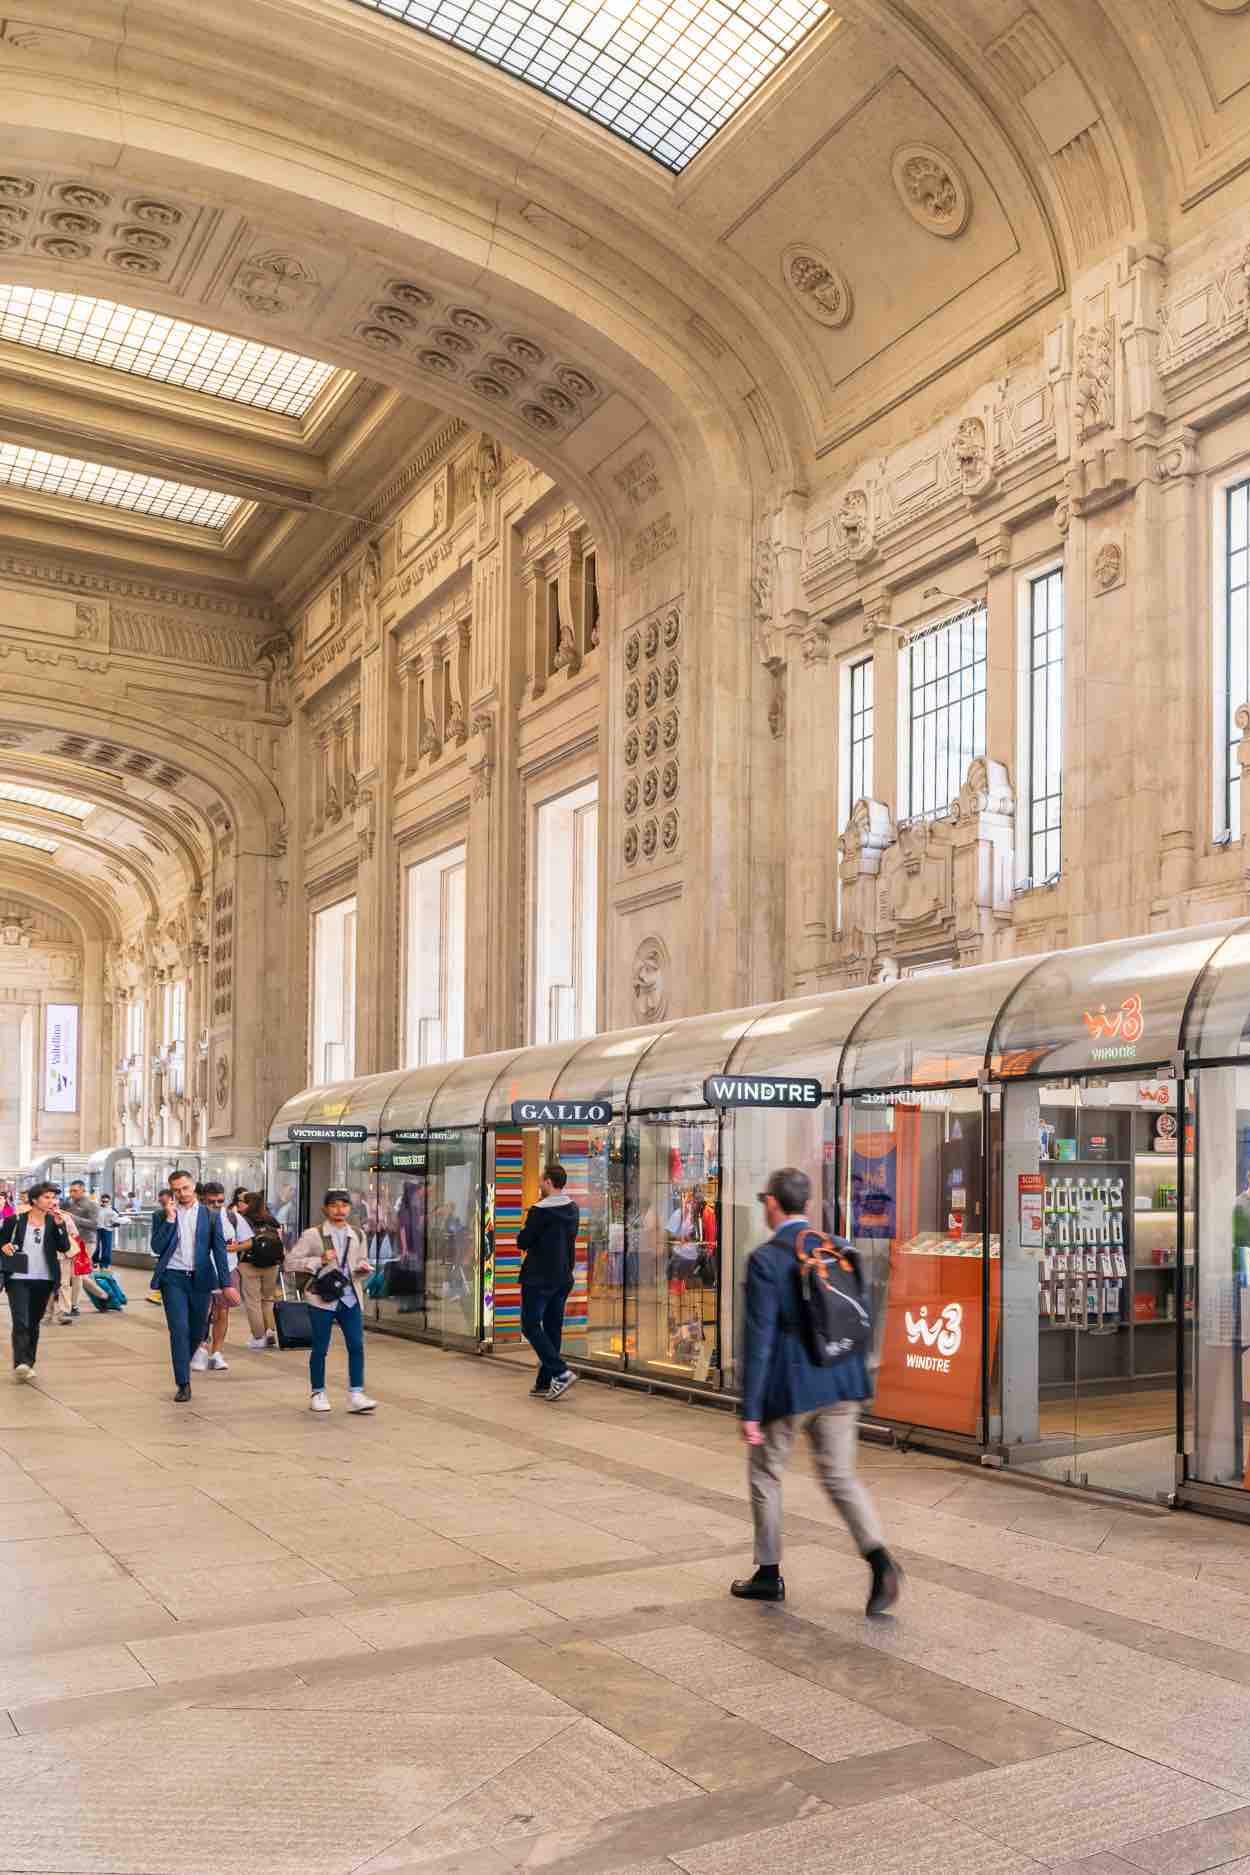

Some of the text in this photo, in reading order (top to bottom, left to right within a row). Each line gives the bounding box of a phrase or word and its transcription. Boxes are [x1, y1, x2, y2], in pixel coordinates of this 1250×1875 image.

[713, 1081, 817, 1102] WINDTRE
[519, 1103, 605, 1121] GALLO
[337, 1129, 364, 1139] SECRET
[906, 1353, 951, 1373] WINDTRE
